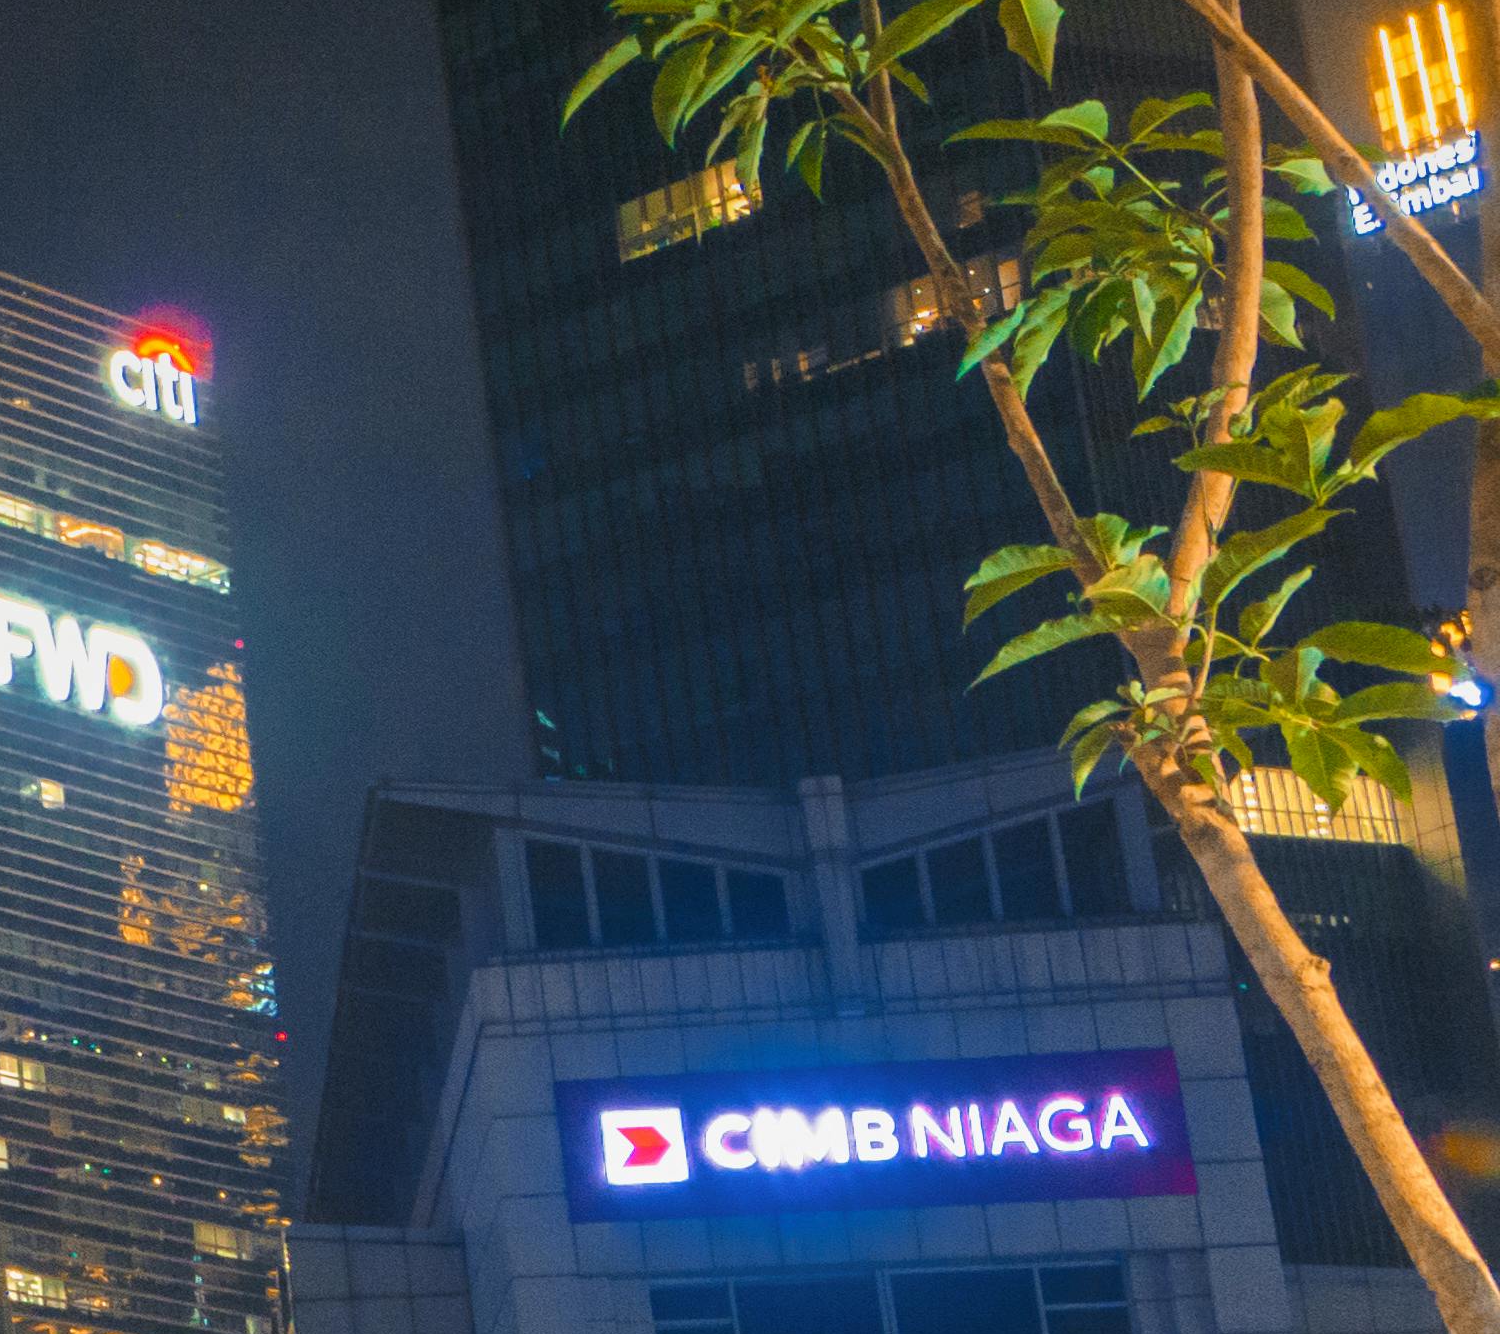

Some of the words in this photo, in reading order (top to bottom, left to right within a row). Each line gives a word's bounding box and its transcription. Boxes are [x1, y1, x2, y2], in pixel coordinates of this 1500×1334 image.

[110, 350, 198, 424] citi
[704, 1108, 899, 1170] CIMB
[910, 1095, 1149, 1160] NIAGA
